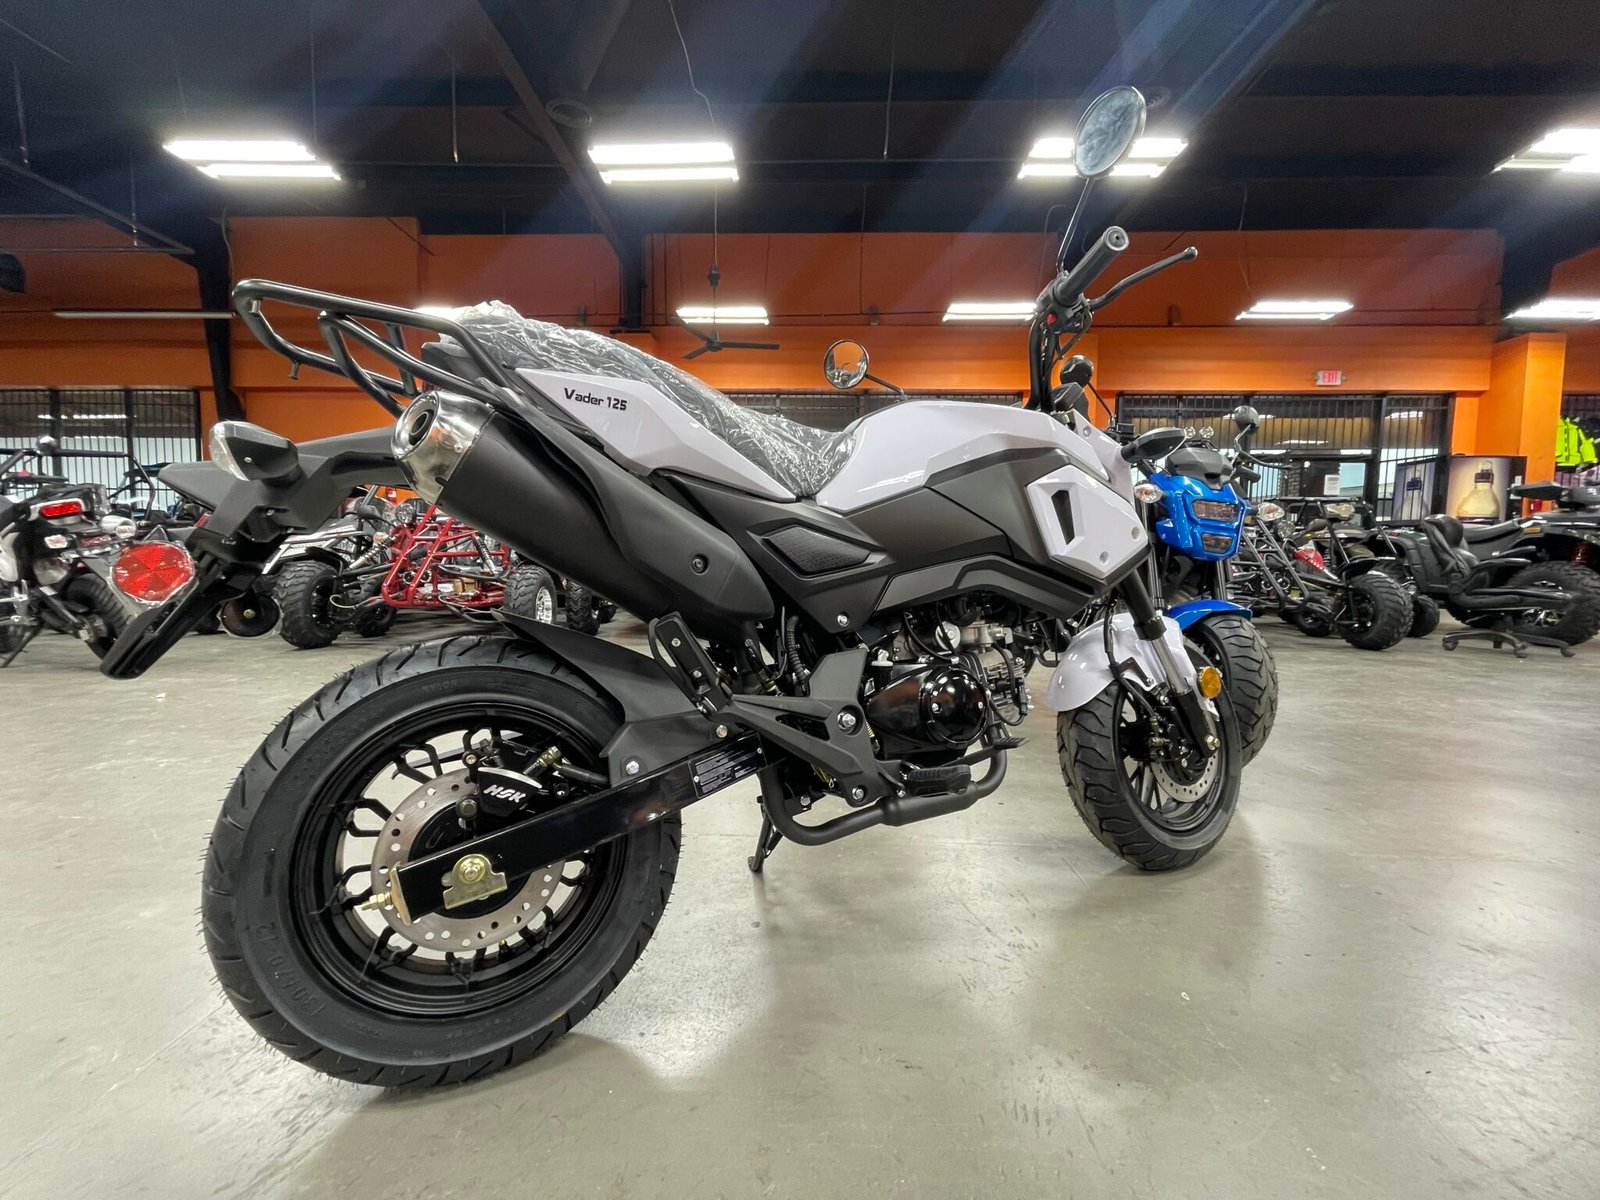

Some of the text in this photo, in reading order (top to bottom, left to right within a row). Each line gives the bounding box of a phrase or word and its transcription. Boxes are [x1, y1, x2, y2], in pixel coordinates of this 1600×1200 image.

[564, 387, 628, 411] Vader 125
[483, 784, 527, 803] HSK
